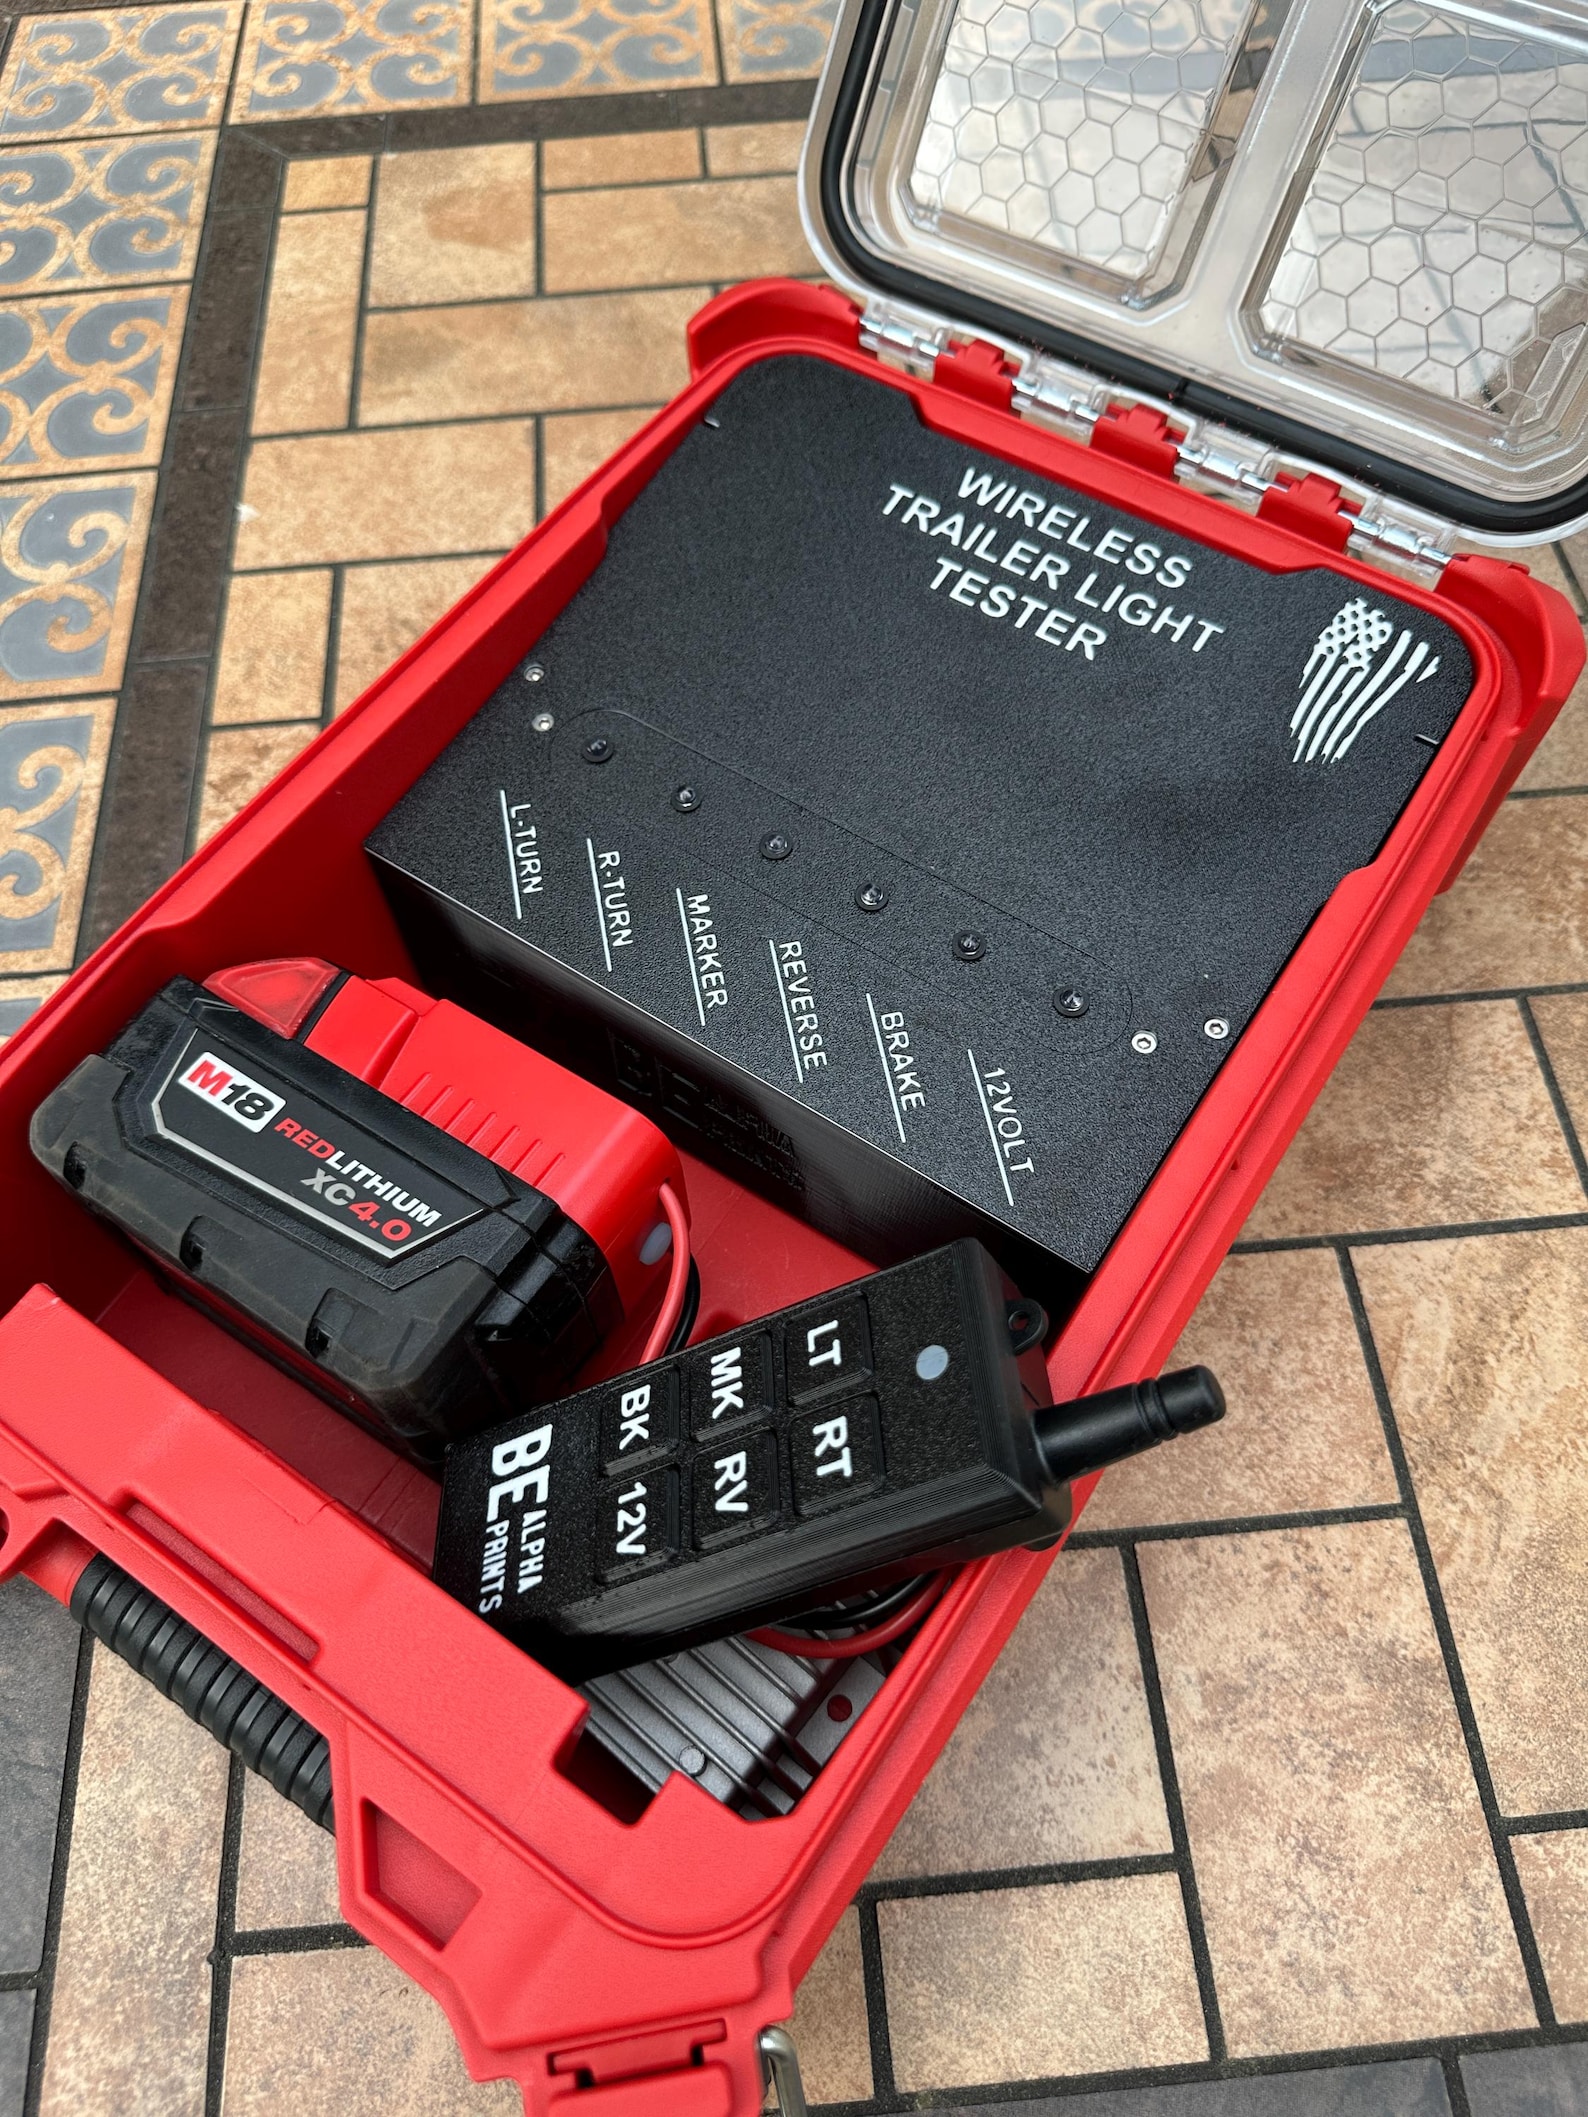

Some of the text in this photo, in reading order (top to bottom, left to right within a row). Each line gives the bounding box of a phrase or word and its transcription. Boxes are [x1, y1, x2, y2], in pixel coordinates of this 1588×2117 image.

[882, 484, 1225, 652] TRAILER LIGHT
[957, 467, 1193, 588] WIRELESS
[929, 557, 1107, 661] TESTER
[687, 894, 729, 1009] MARKER
[778, 940, 828, 1070] REVERSE
[187, 1059, 275, 1121] M18
[880, 1011, 926, 1111] BRAKE
[983, 1067, 1034, 1173] 12VOLT
[273, 1117, 442, 1228] REDLITHIUM
[709, 1347, 744, 1419] MK
[806, 1320, 842, 1366] LT
[618, 1384, 652, 1450] BK
[813, 1415, 853, 1478] RT
[485, 1424, 554, 1523] BE
[615, 1482, 648, 1555] 12V
[714, 1450, 749, 1512] RV
[478, 1519, 511, 1614] PRINTS
[516, 1508, 548, 1594] ALPHA
